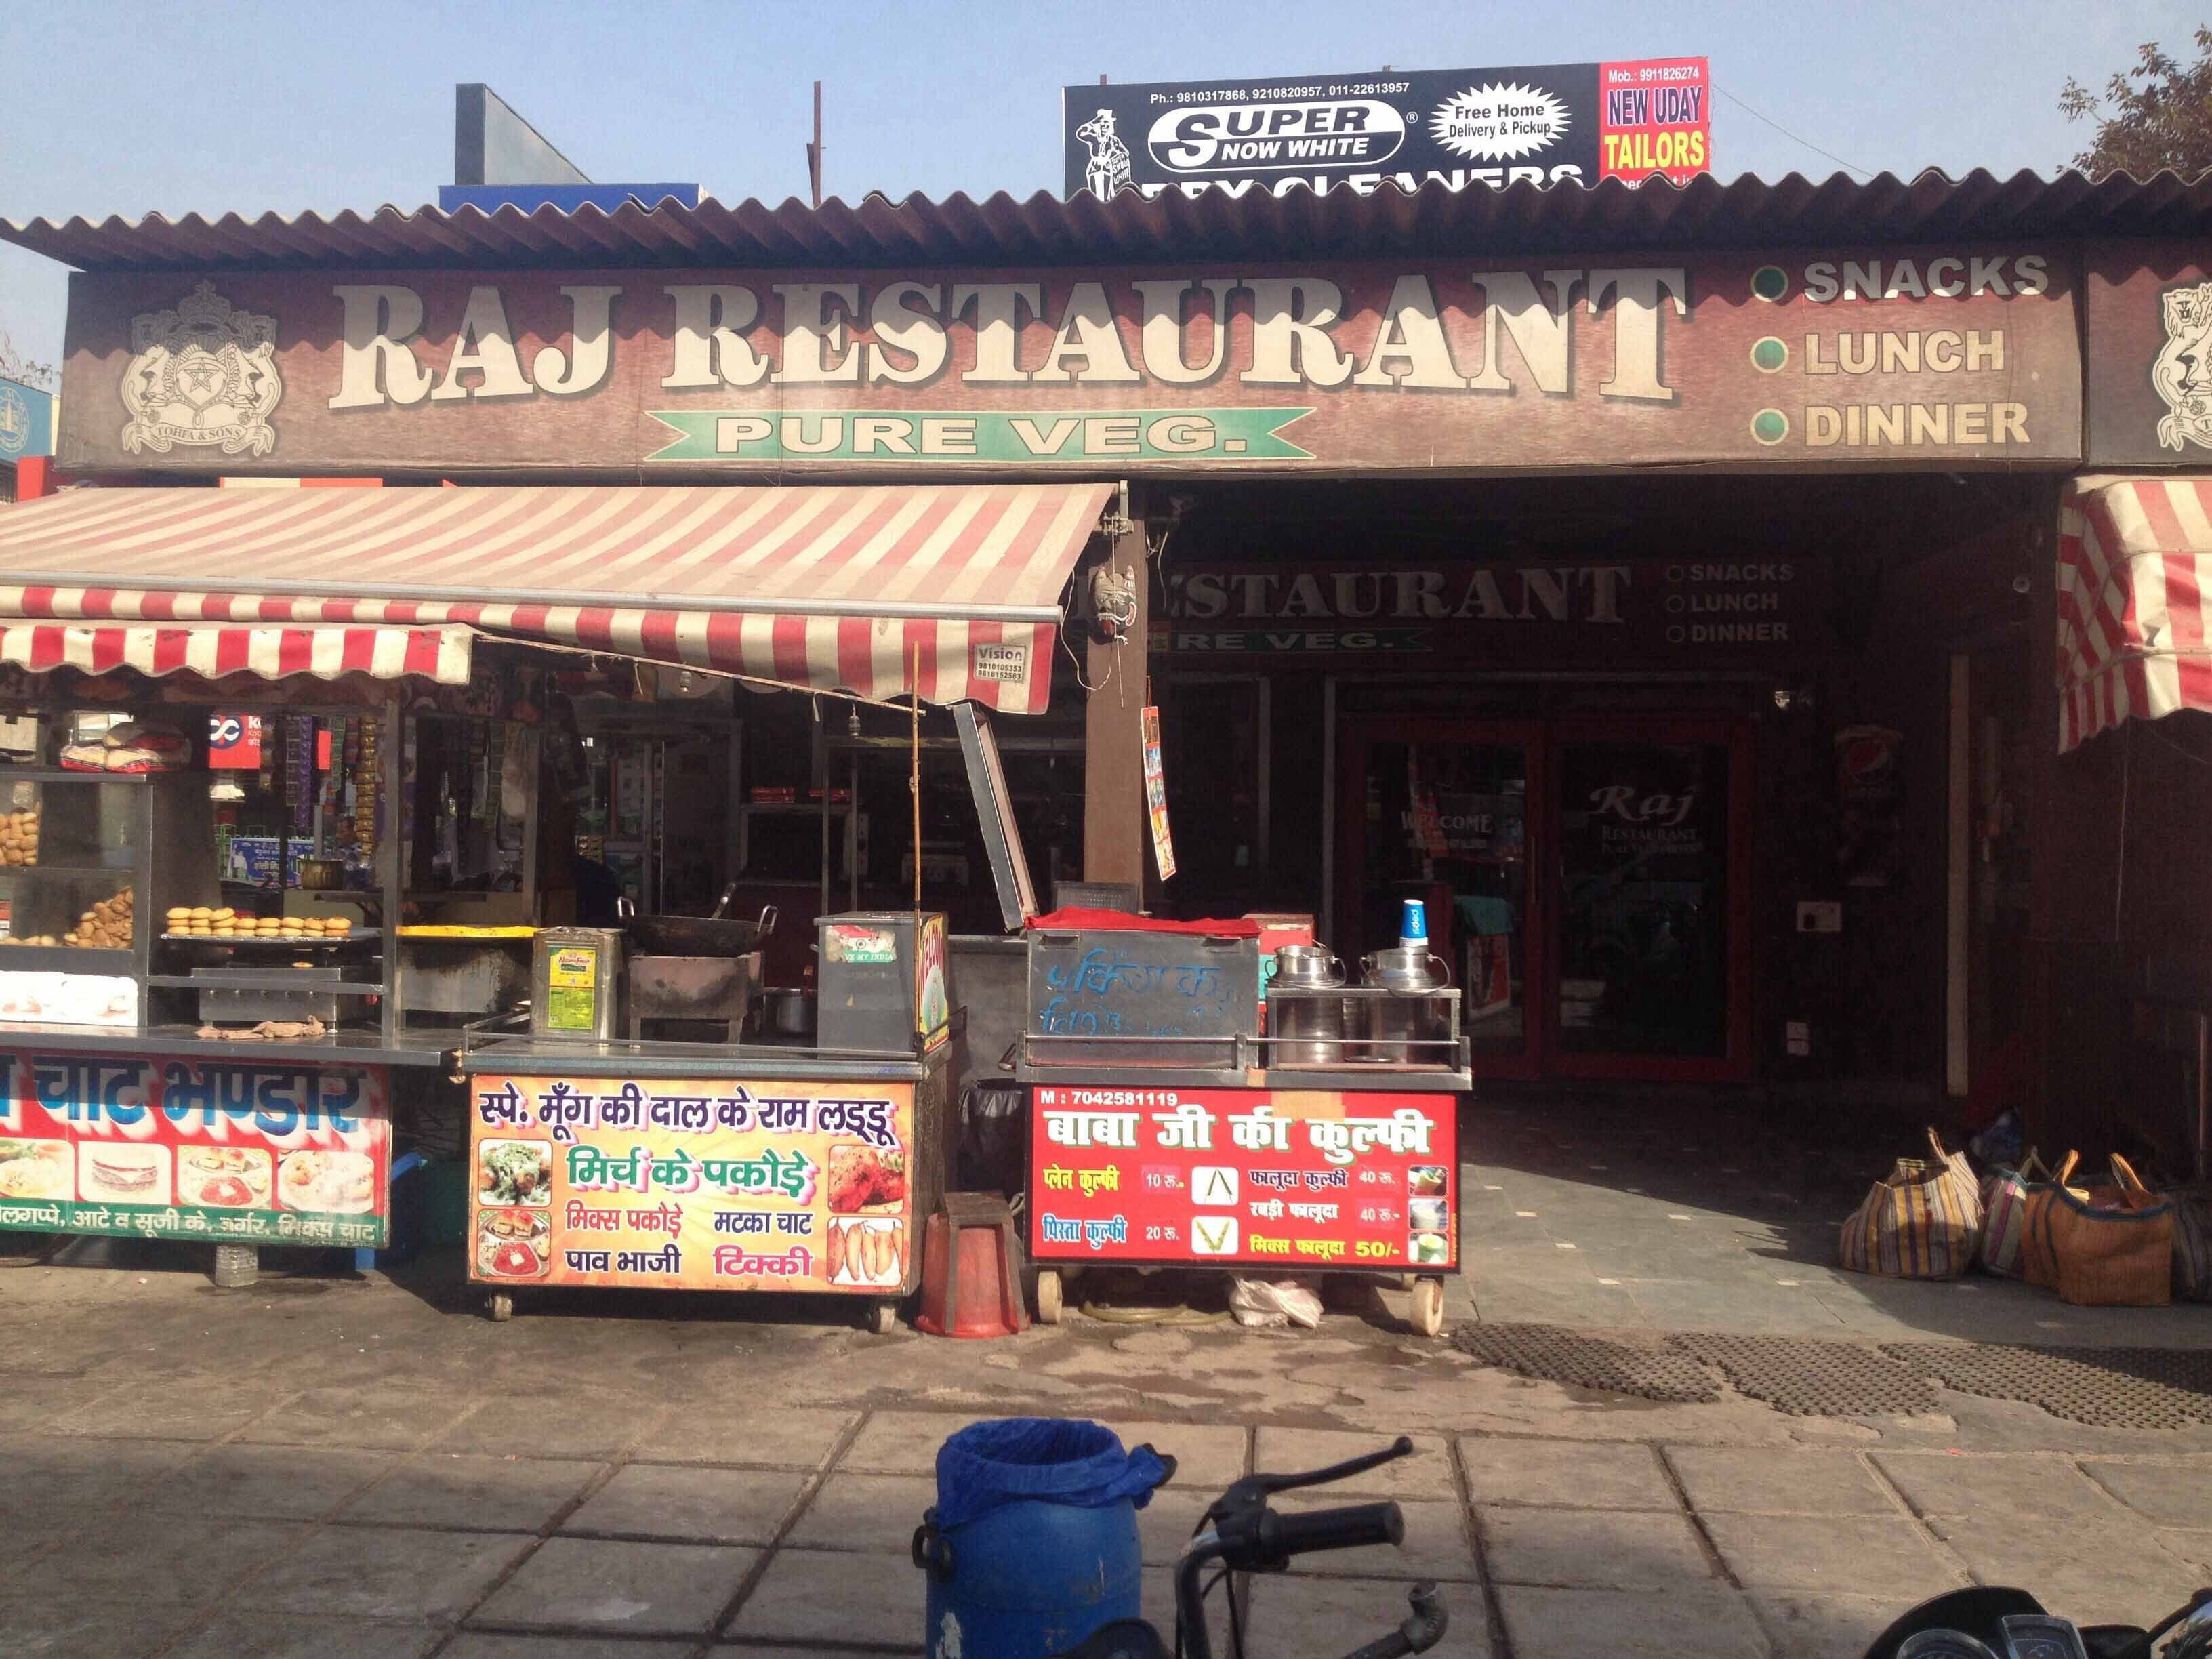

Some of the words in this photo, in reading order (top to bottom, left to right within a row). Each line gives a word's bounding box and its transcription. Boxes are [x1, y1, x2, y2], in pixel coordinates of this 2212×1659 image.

[1608, 70, 1637, 83] Mob.:
[1640, 67, 1699, 81] 9911826274
[1151, 93, 1174, 104] Ph.:
[1177, 90, 1249, 104] 9810317868,
[1252, 87, 1326, 100] 9210820957,
[1329, 83, 1410, 96] 011-22613957
[1608, 89, 1648, 126] NEW
[1654, 86, 1703, 123] UDAY
[1455, 106, 1491, 119] Free
[1498, 103, 1545, 119] Home
[1168, 106, 1371, 167] SUPER
[1449, 123, 1496, 140] Delivery
[1499, 121, 1508, 135] &
[1512, 120, 1551, 138] Pickup
[1288, 136, 1370, 157] WHITE
[1604, 131, 1704, 169] TAILORS
[1803, 255, 2049, 303] SNACKS
[329, 283, 621, 409] RAJ
[661, 268, 1687, 400] RESTAURANT
[1804, 329, 2005, 375] LUNCH
[157, 426, 194, 441] TOHFA
[197, 431, 207, 441] &
[209, 426, 242, 440] SONS
[716, 416, 978, 455] PURE
[1009, 415, 1248, 455] VEG.
[1804, 402, 2032, 447] DINNER
[1689, 562, 1794, 583] SNACKS
[1690, 592, 1778, 613] LUNCH
[1264, 632, 1394, 651] VEG.
[1690, 621, 1788, 643] DINNER
[978, 647, 1023, 661] Vision
[1588, 784, 1699, 827] Raj
[33, 1055, 149, 1126] चाट
[163, 1061, 367, 1136] भण्डार
[1071, 1091, 1179, 1106] 7042581119
[479, 1081, 529, 1124] स्पे.
[539, 1081, 590, 1141] मूँग
[601, 1082, 640, 1126] की
[650, 1097, 710, 1129] दाल
[718, 1086, 747, 1128] के
[758, 1098, 809, 1129] राम
[817, 1099, 895, 1147] लड्डू
[1042, 1111, 1140, 1147] बाबा
[1151, 1103, 1216, 1149] जी
[1305, 1108, 1435, 1165] कुल्फी
[566, 1145, 640, 1187] मिर्च
[651, 1148, 693, 1185] के
[703, 1147, 813, 1200] पकौड़े
[1042, 1163, 1074, 1190] प्लेन
[1078, 1164, 1120, 1198] कुल्फी
[1146, 1173, 1160, 1187] 10
[1249, 1169, 1300, 1192] फालूदा
[1303, 1168, 1351, 1193] कुल्फी
[1359, 1170, 1376, 1183] 40
[0, 1203, 66, 1227] लगप्पे,
[72, 1206, 111, 1229] आटे
[115, 1212, 131, 1228] व
[134, 1208, 181, 1239] सूजी
[338, 1223, 377, 1241] चाट
[565, 1200, 620, 1231] मिक्स
[626, 1201, 683, 1240] पकौड़े
[714, 1210, 771, 1234] मटका
[777, 1210, 813, 1235] चाट
[1288, 1202, 1340, 1224] फालूदा
[1360, 1207, 1376, 1221] 40
[1042, 1213, 1082, 1242] पिस्ता
[1084, 1214, 1128, 1250] कुल्फी
[1146, 1226, 1161, 1240] 20
[565, 1248, 610, 1273] पाव
[616, 1243, 682, 1274] भाजी
[713, 1244, 812, 1277] टिक्की
[1249, 1234, 1291, 1254] मिक्स
[1295, 1239, 1347, 1261] फालूदा
[1355, 1240, 1400, 1258] 50/-
